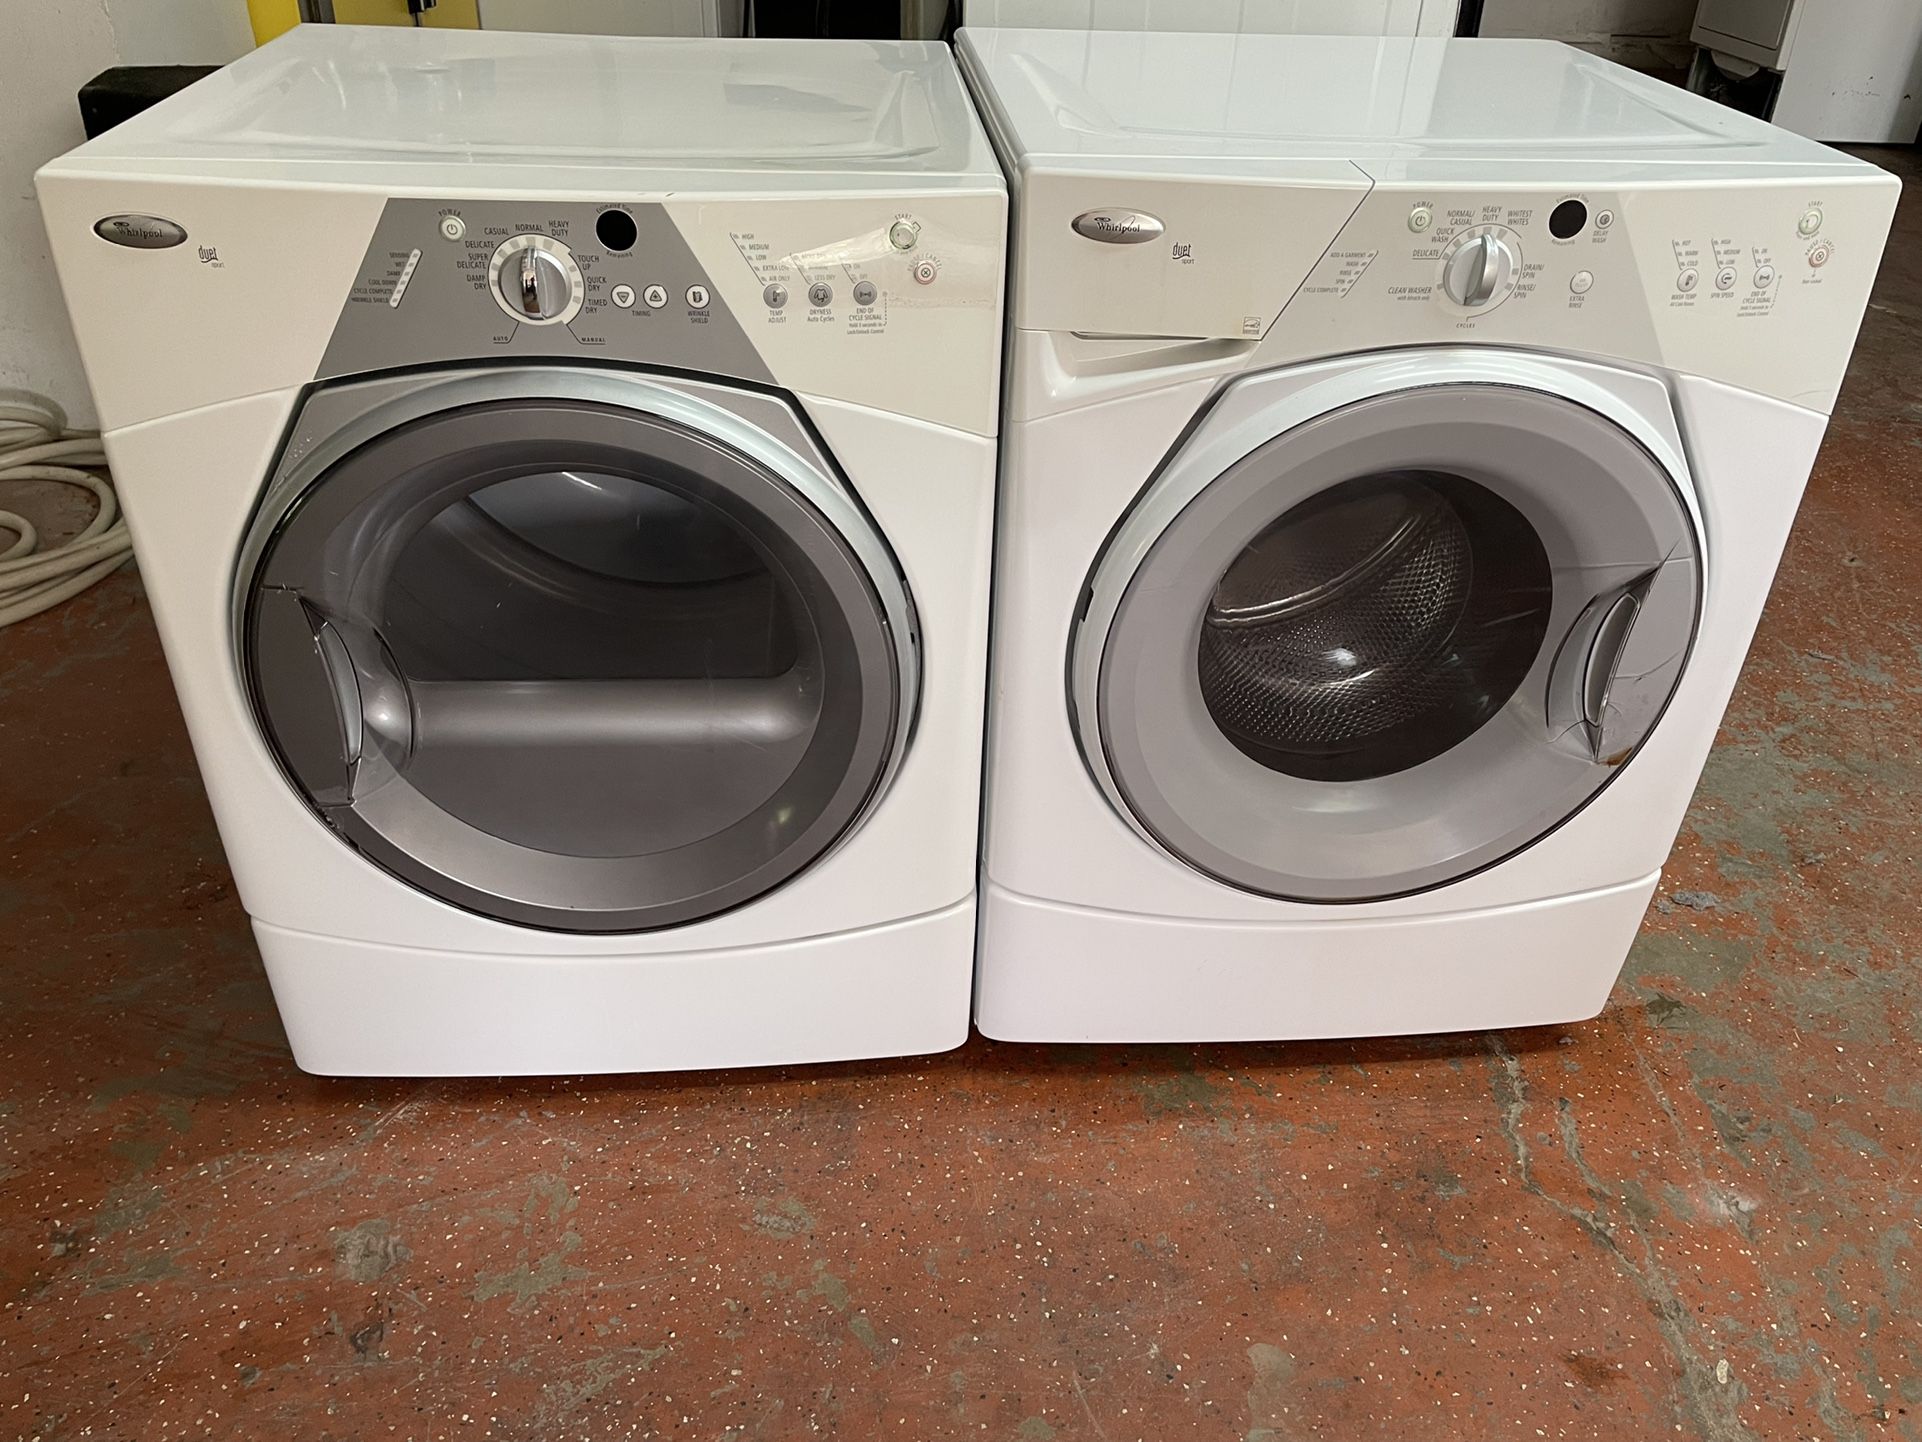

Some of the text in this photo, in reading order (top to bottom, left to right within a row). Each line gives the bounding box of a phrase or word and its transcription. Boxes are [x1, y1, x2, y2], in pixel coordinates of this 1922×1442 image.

[1413, 201, 1433, 209] POWER
[438, 208, 461, 217] POWER
[1447, 210, 1475, 218] NORMAL/
[1482, 206, 1502, 214] HEAVY
[1507, 210, 1532, 218] WHITEST
[1482, 214, 1499, 222] DUTY
[1507, 218, 1529, 226] WHITES
[515, 224, 544, 232] NORMAL
[548, 220, 569, 229] HEAVY
[1097, 221, 1140, 234] Whirlpool
[117, 226, 163, 240] Whirlpool
[484, 227, 509, 236] CASUAL
[551, 229, 568, 237] DUTY
[465, 241, 495, 249] DELICATE
[198, 245, 218, 261] duet
[1172, 242, 1191, 257] duet
[1413, 249, 1439, 257] DELICATE
[468, 253, 489, 261] SUPER
[578, 255, 600, 263] TOUCH
[457, 261, 486, 269] DELICATE
[582, 263, 591, 271] UP
[1522, 271, 1535, 279] SPIN
[586, 276, 607, 284] QUICK
[474, 282, 486, 290] DRY
[588, 284, 601, 292] DRY
[1517, 284, 1536, 292] RINSE/
[585, 306, 598, 314] DRY
